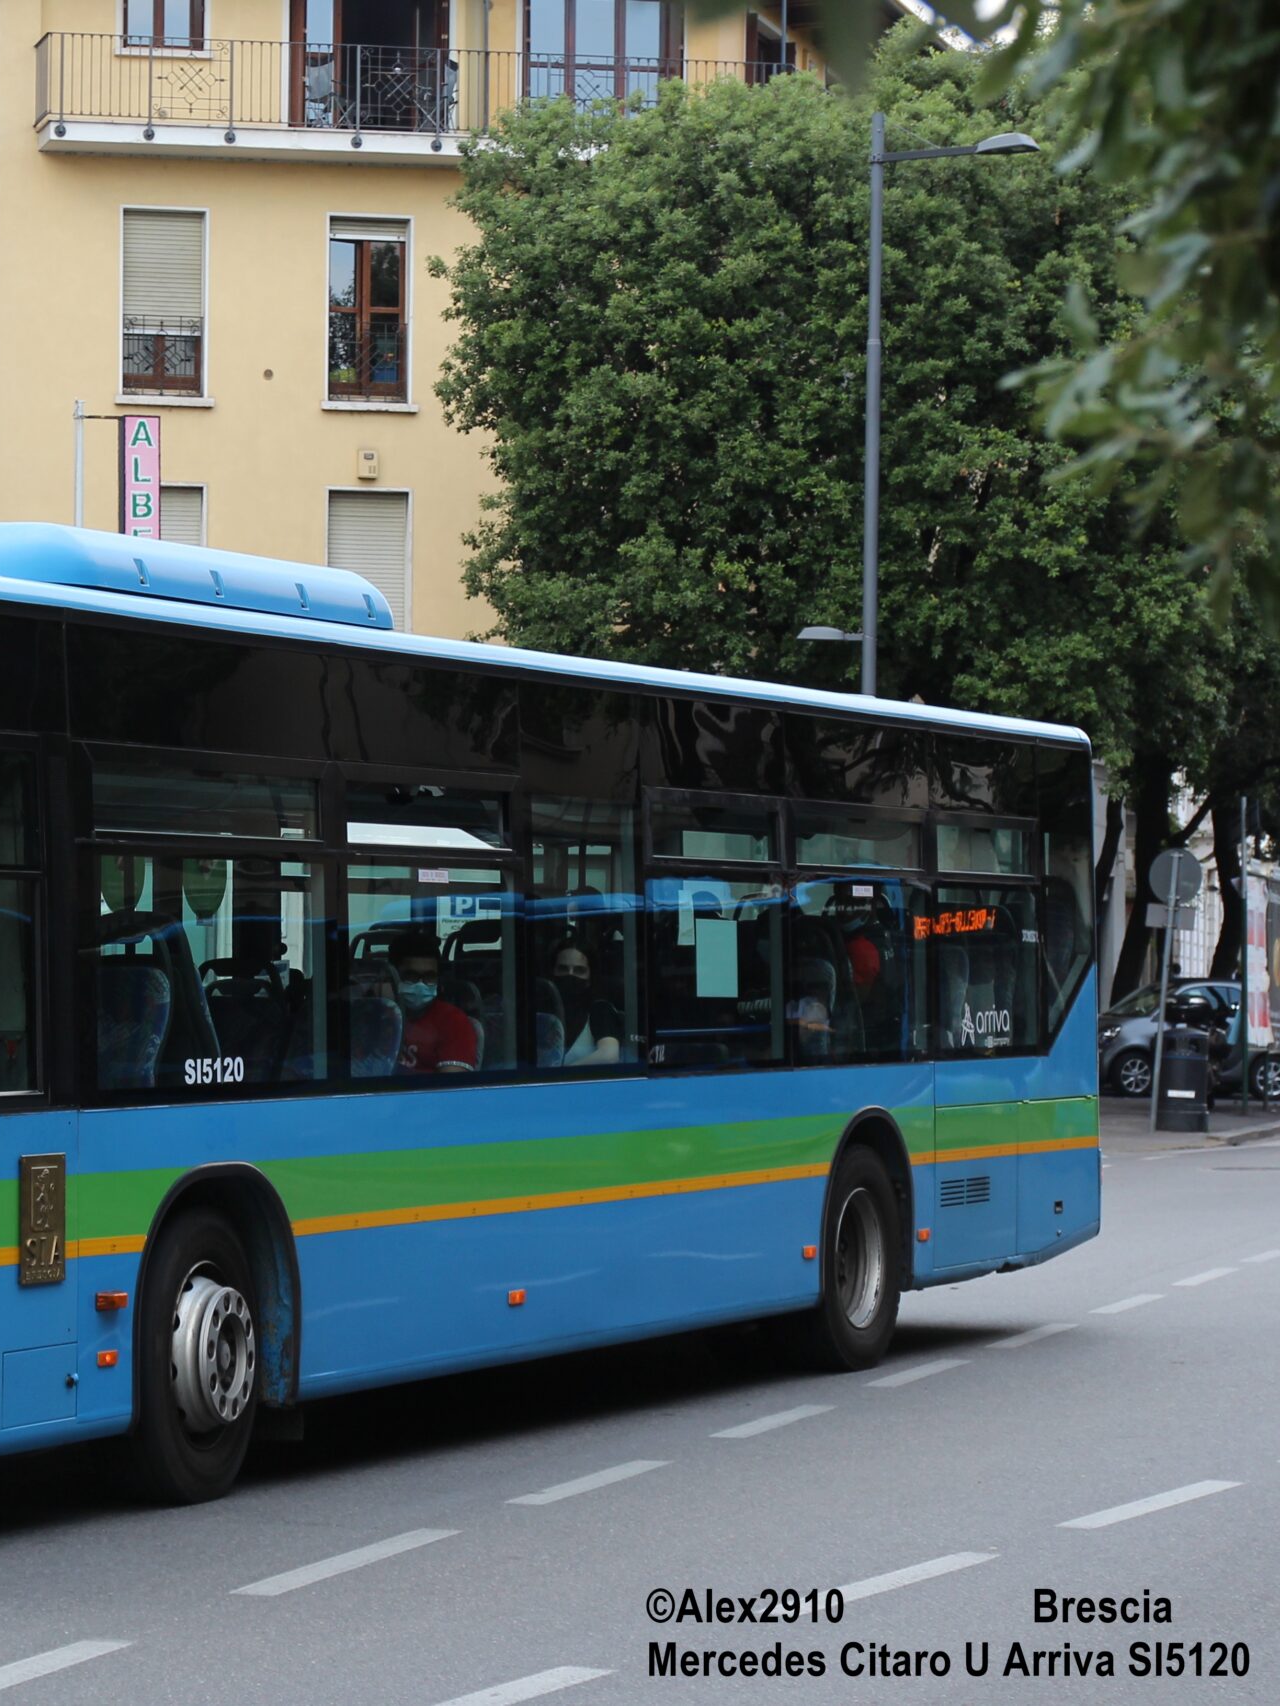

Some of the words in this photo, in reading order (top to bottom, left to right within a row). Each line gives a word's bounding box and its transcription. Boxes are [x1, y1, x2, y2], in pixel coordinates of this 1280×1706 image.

[130, 419, 154, 538] ALB
[976, 1003, 1011, 1034] arriva
[184, 1056, 244, 1086] SI5120
